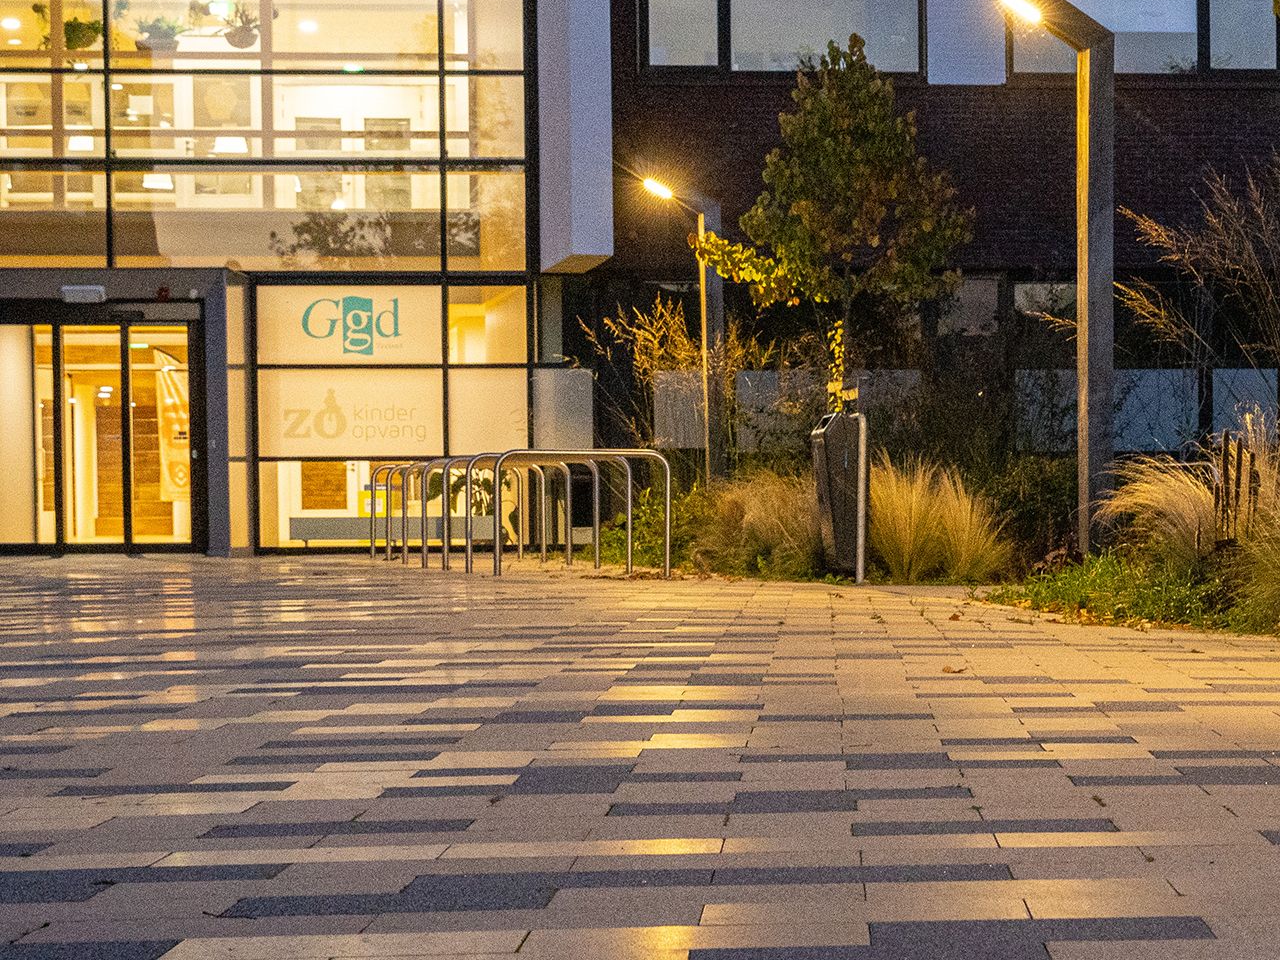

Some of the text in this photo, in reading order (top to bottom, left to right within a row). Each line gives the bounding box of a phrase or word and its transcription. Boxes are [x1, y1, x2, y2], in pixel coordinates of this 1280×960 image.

[301, 296, 401, 355] Ggd
[352, 404, 417, 421] kinder
[351, 424, 427, 442] opvang
